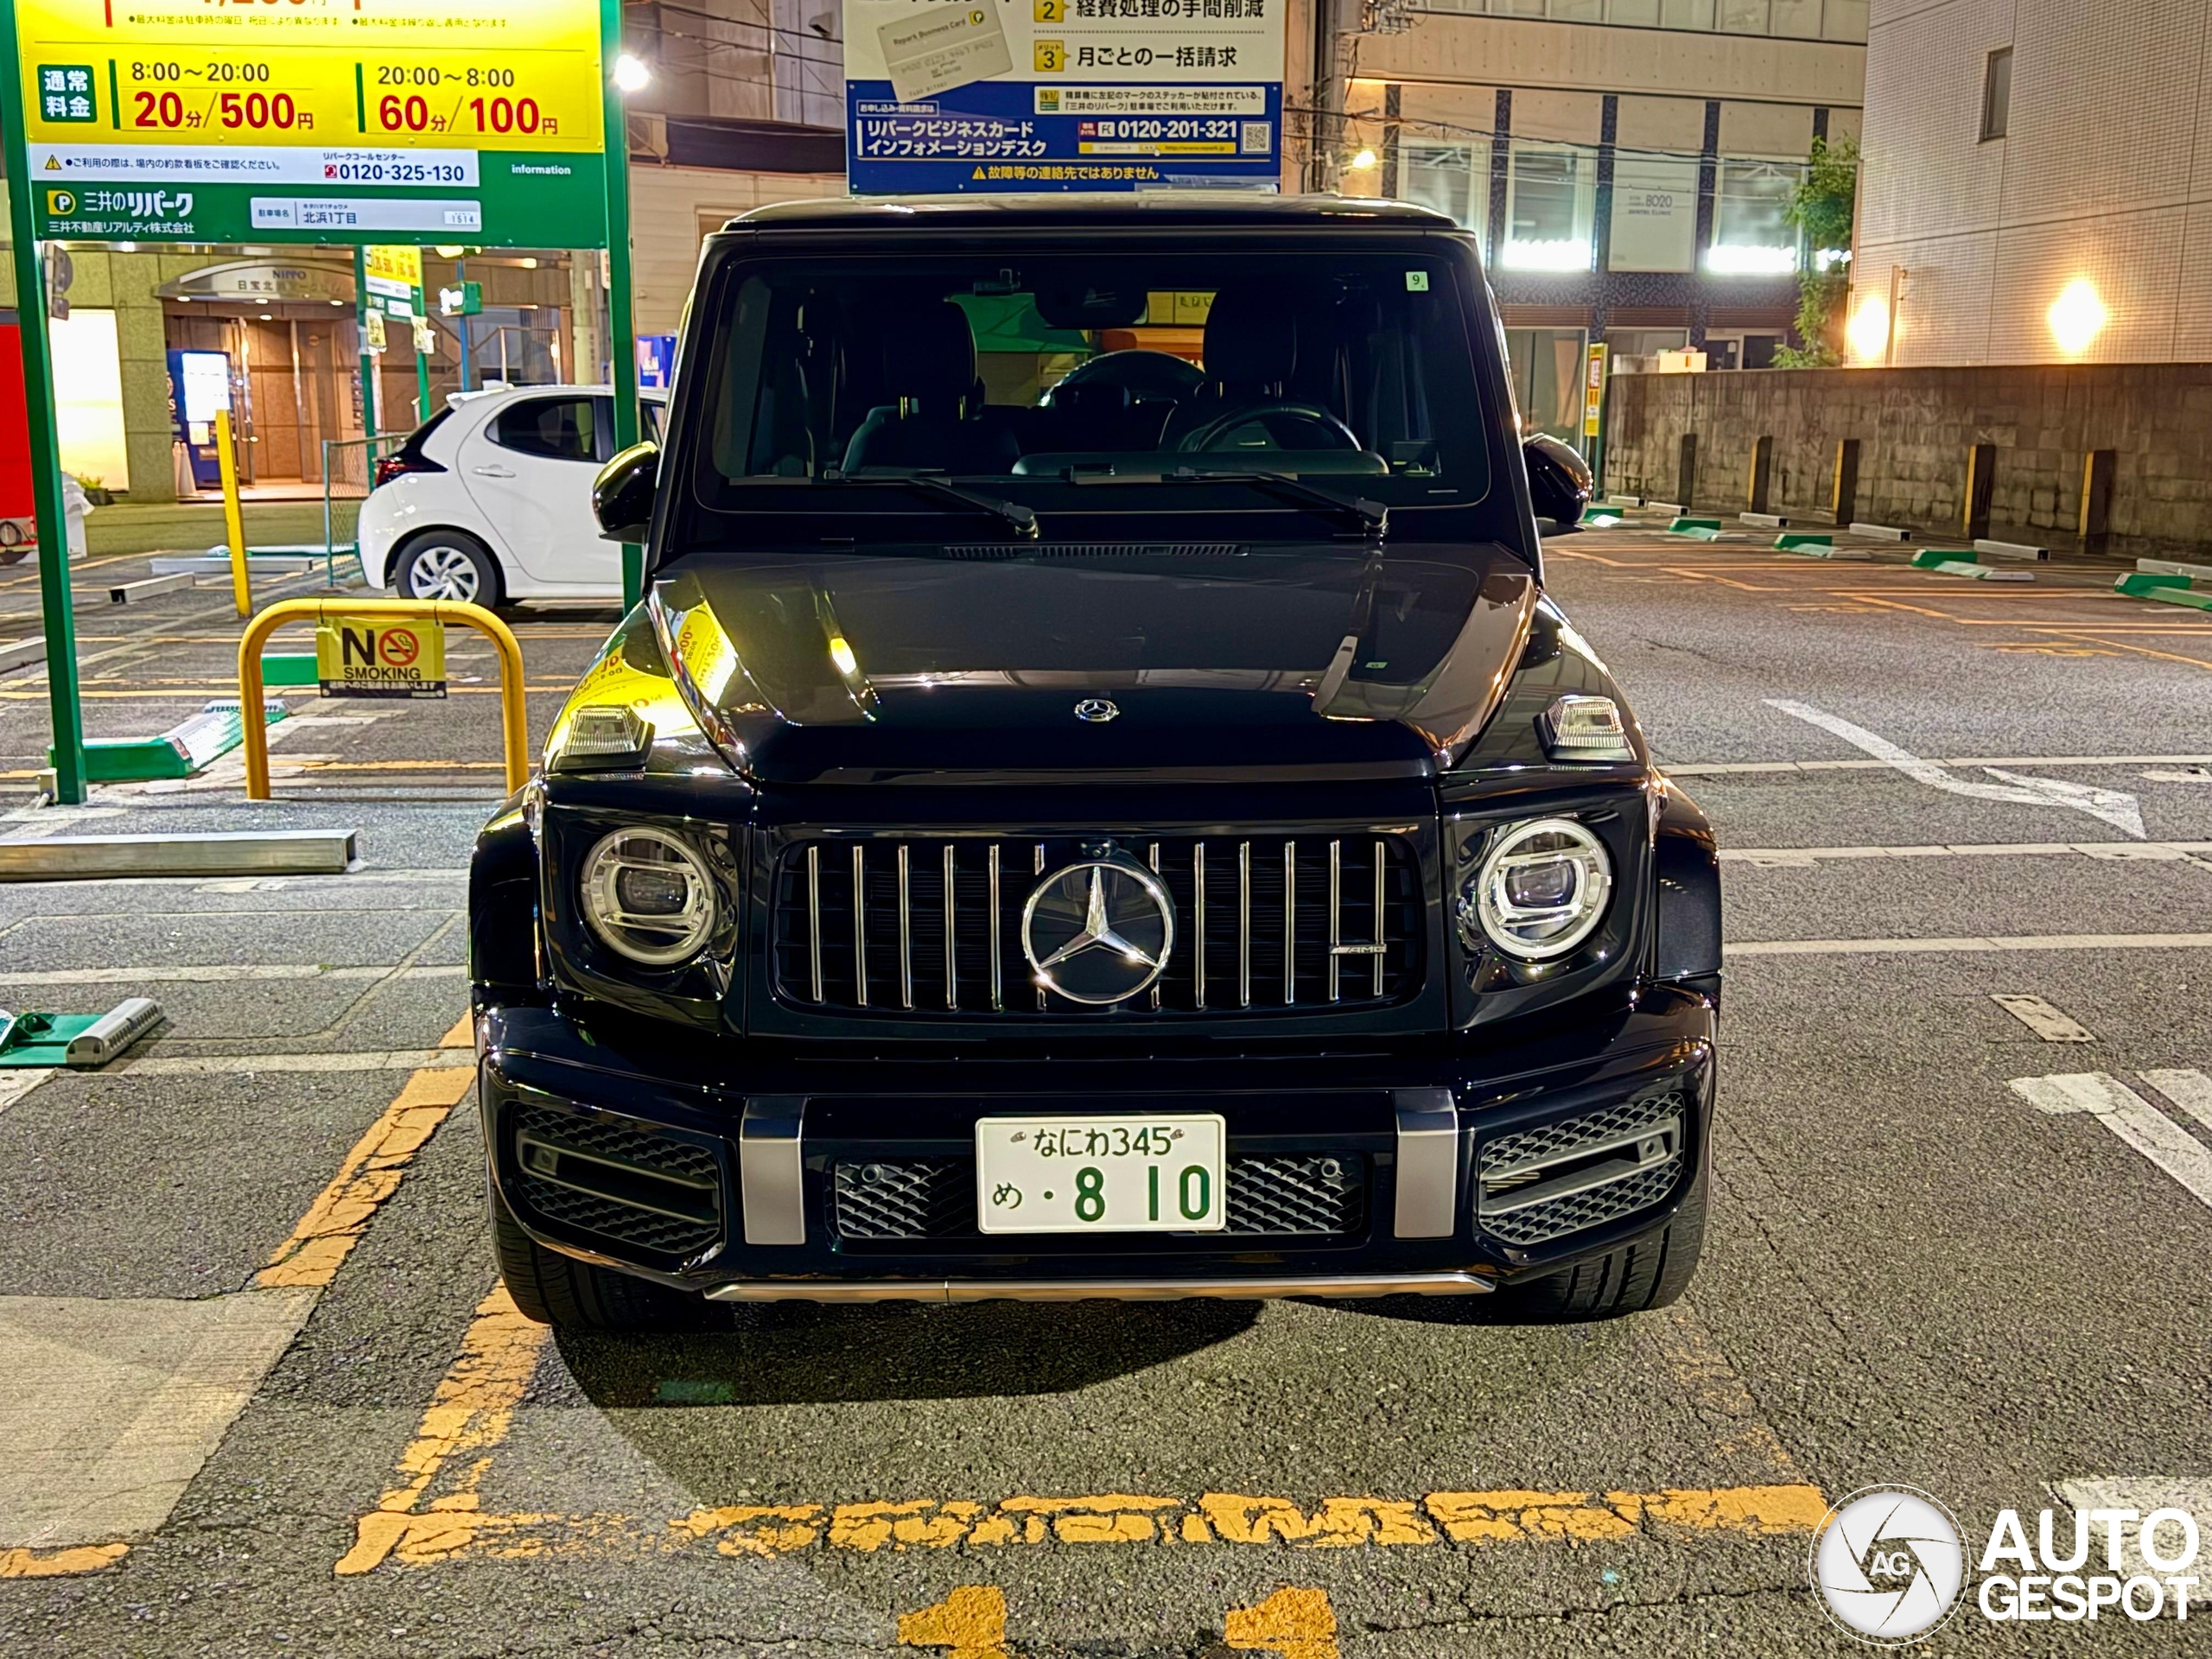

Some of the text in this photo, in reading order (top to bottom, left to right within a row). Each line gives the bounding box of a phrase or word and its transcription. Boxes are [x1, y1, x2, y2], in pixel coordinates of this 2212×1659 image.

[1043, 2, 1055, 19] 2
[1077, 0, 1264, 18] 経費処理の手間削減
[1043, 51, 1056, 69] 3
[1077, 47, 1237, 67] 月ごとの一括請求
[44, 70, 88, 92] 通常
[46, 96, 91, 118] 料金
[867, 120, 1033, 138] リパークビジネスカード
[1118, 120, 1237, 138] 0120-201-321
[867, 139, 1046, 156] インフォメーションデスク
[323, 152, 406, 162] リパークコールセンター
[340, 163, 465, 181] 0120-325-130
[512, 164, 571, 175] information
[988, 166, 1160, 180] 故障等の連絡先ではありません
[84, 190, 194, 218] 三井のリパーク
[302, 212, 357, 225] 北浜1丁目
[48, 221, 195, 234] 三井不動産リアルティ株式会社
[272, 270, 307, 280] NIPPO
[1412, 274, 1421, 285] 9
[343, 666, 421, 680] SMOKING
[993, 1182, 1022, 1210] め
